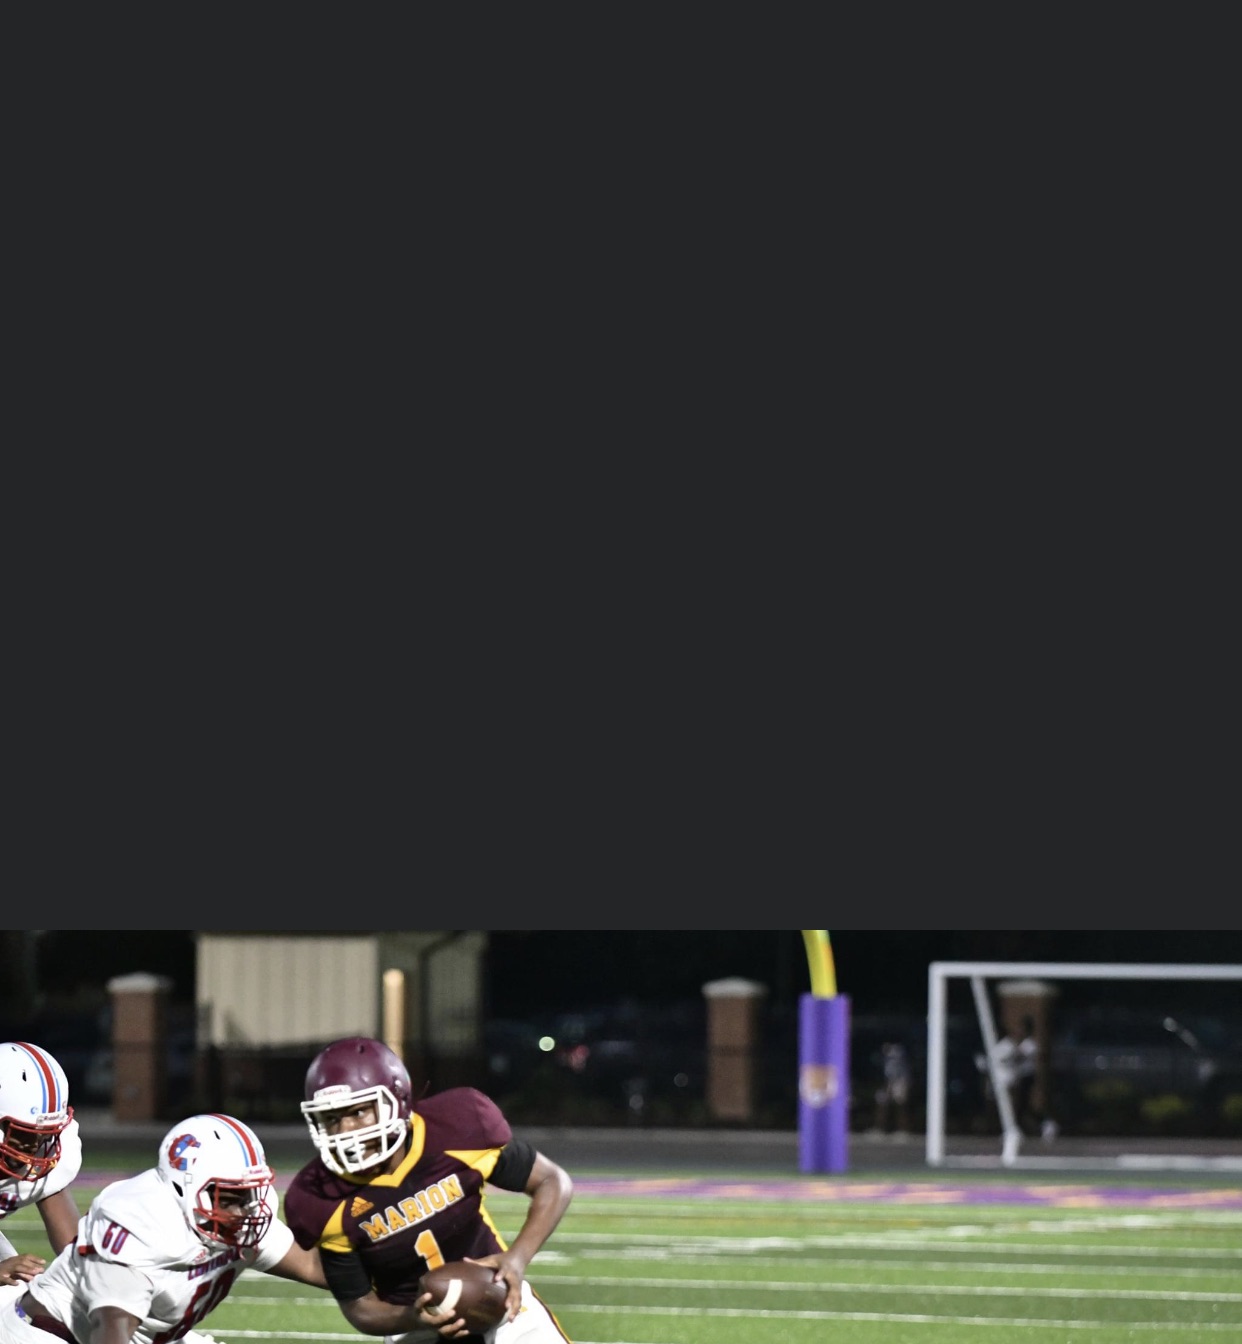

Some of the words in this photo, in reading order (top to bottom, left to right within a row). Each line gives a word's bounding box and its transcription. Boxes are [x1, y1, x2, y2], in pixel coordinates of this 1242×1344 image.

[359, 1173, 465, 1243] MARION
[101, 1220, 130, 1256] 60
[414, 1229, 445, 1271] 1
